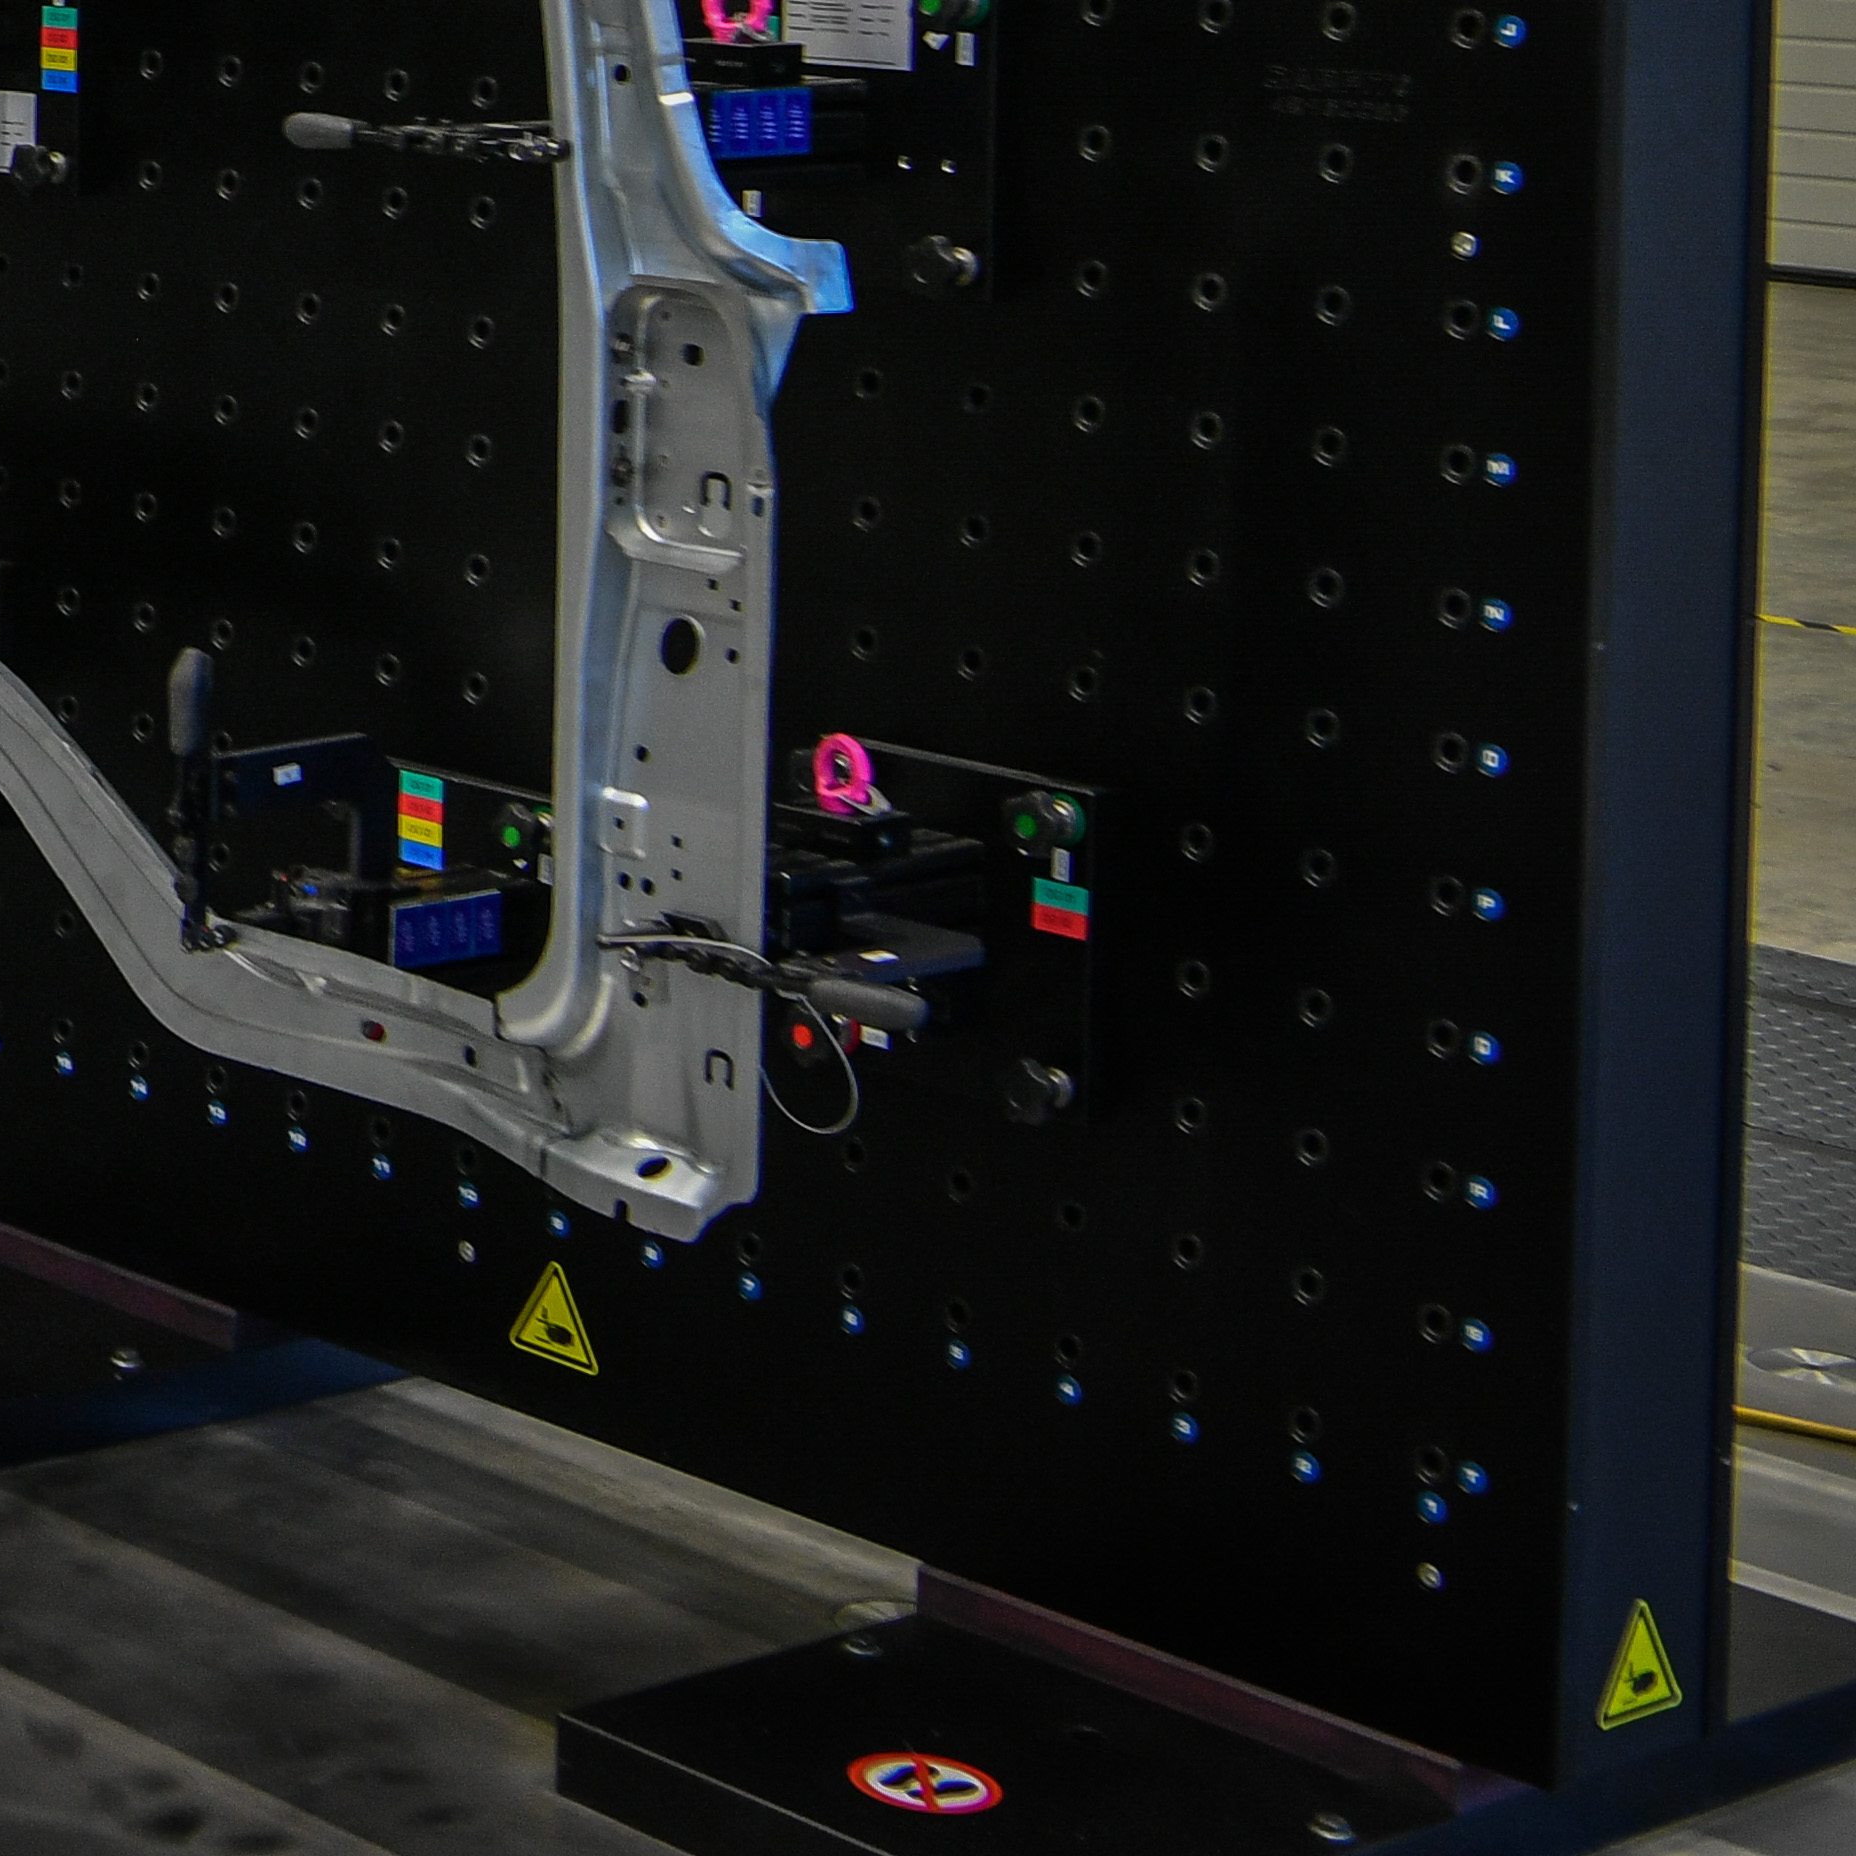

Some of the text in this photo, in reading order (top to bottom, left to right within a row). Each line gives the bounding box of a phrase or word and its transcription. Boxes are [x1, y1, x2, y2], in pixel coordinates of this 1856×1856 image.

[1499, 23, 1518, 37] J
[1494, 168, 1515, 184] K
[1492, 314, 1511, 330] L
[1486, 459, 1510, 476] M
[1476, 893, 1496, 910] P
